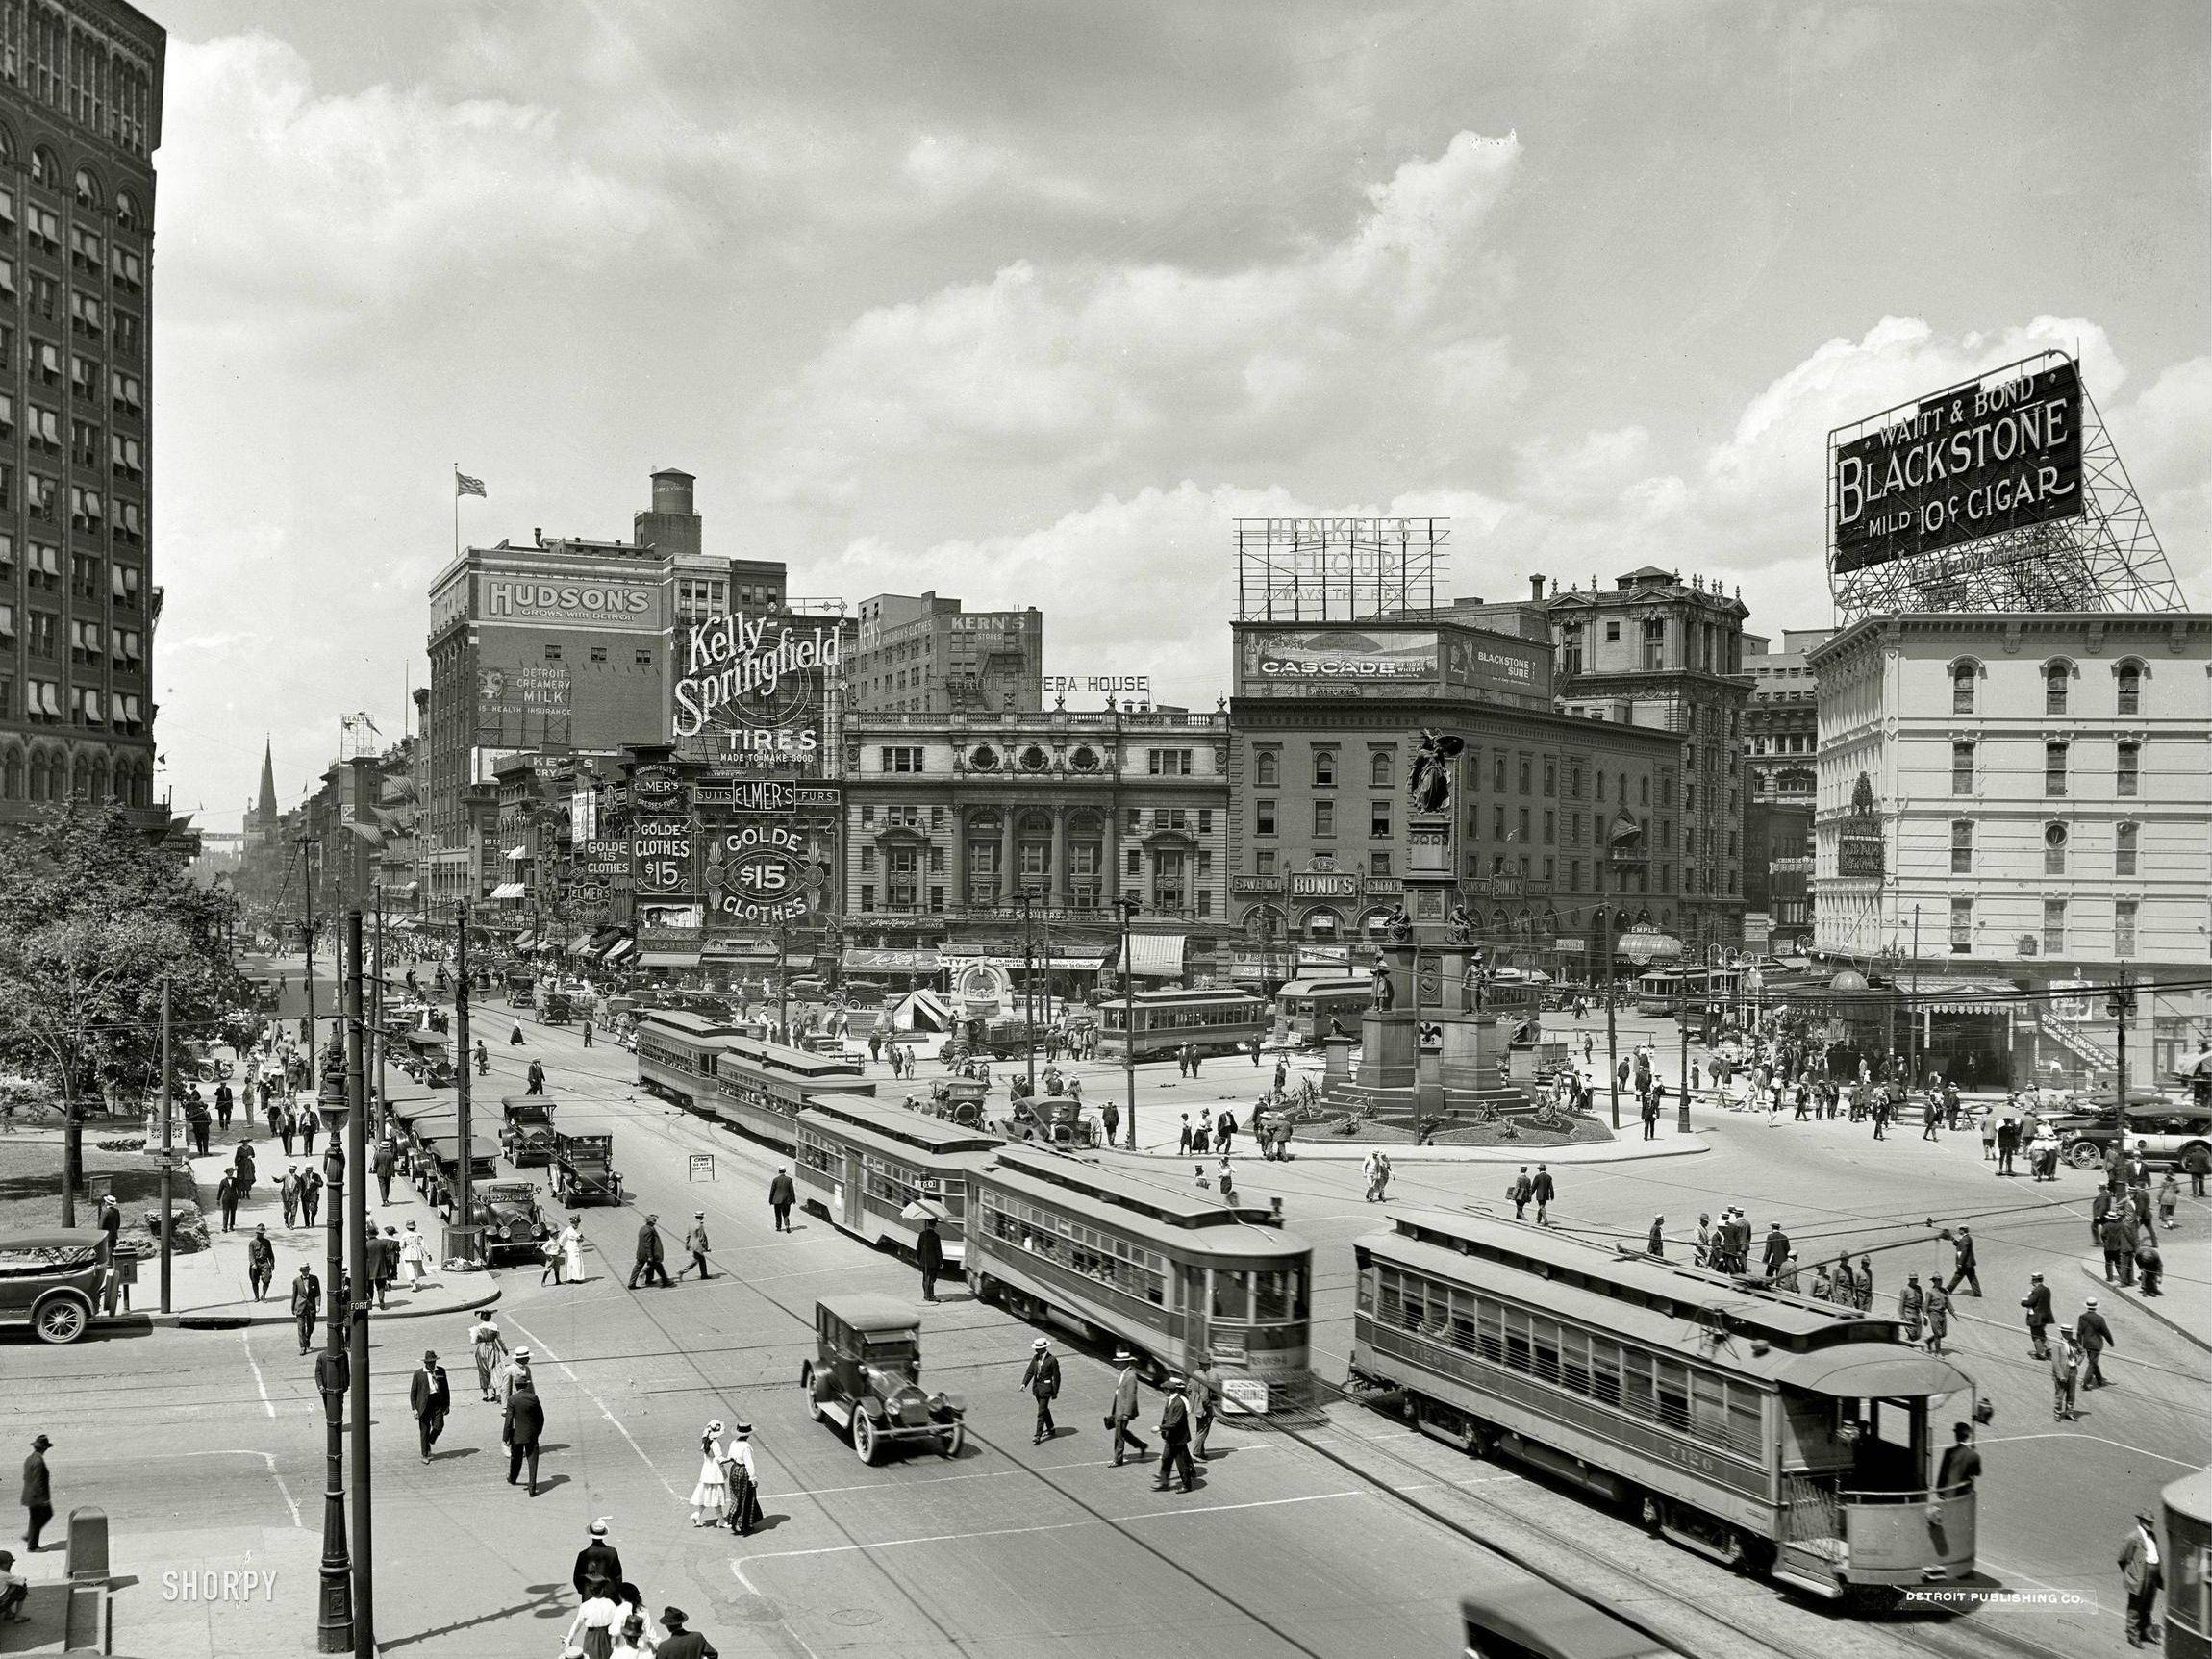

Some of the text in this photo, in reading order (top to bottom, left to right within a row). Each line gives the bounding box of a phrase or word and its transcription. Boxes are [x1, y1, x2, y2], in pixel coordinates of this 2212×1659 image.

[1879, 374, 2035, 448] WAITT & BOND
[1837, 398, 2069, 526] BLACKSTONE
[1869, 511, 1911, 538] MILD
[1967, 466, 2075, 520] CIGAR
[1268, 518, 1411, 542] HENKEL'S
[1295, 551, 1398, 576] FLOUR
[1947, 554, 1981, 575] CADY
[490, 581, 650, 616] HUDSON'S
[521, 608, 563, 617] GROWS
[592, 613, 637, 622] DETROIT
[951, 616, 1026, 630] KERN'S
[1261, 661, 1395, 674] CASCADE
[1478, 651, 1529, 669] BLACKSTONE
[522, 667, 566, 679] DETROIT
[673, 626, 840, 737] Springfield
[1508, 667, 1529, 679] SURE
[516, 678, 571, 690] CREAMERY
[1088, 676, 1147, 691] HOUSE
[523, 691, 564, 703] MILK
[491, 705, 521, 714] HEALTH
[527, 707, 572, 716] INSURANCE
[725, 729, 817, 750] TIRES
[792, 754, 814, 763] GOOD
[634, 781, 679, 792] ELMER'S
[697, 782, 834, 810] SUITS ELMER'S FURS
[641, 824, 681, 836] GOLDE
[587, 842, 629, 854] GOLDE
[726, 827, 803, 852] GOLDE
[635, 840, 690, 858] CLOTHES
[587, 863, 629, 873] CLOTHES
[645, 861, 679, 885] $15
[740, 865, 786, 890] $15
[1294, 876, 1353, 895] BOND'S
[1368, 880, 1403, 892] CLOTH
[1495, 879, 1522, 895] BOND'S
[723, 895, 807, 923] CLOTHES
[993, 911, 1011, 919] THE
[350, 1301, 367, 1310] FORT
[1669, 1445, 1714, 1470] 7126
